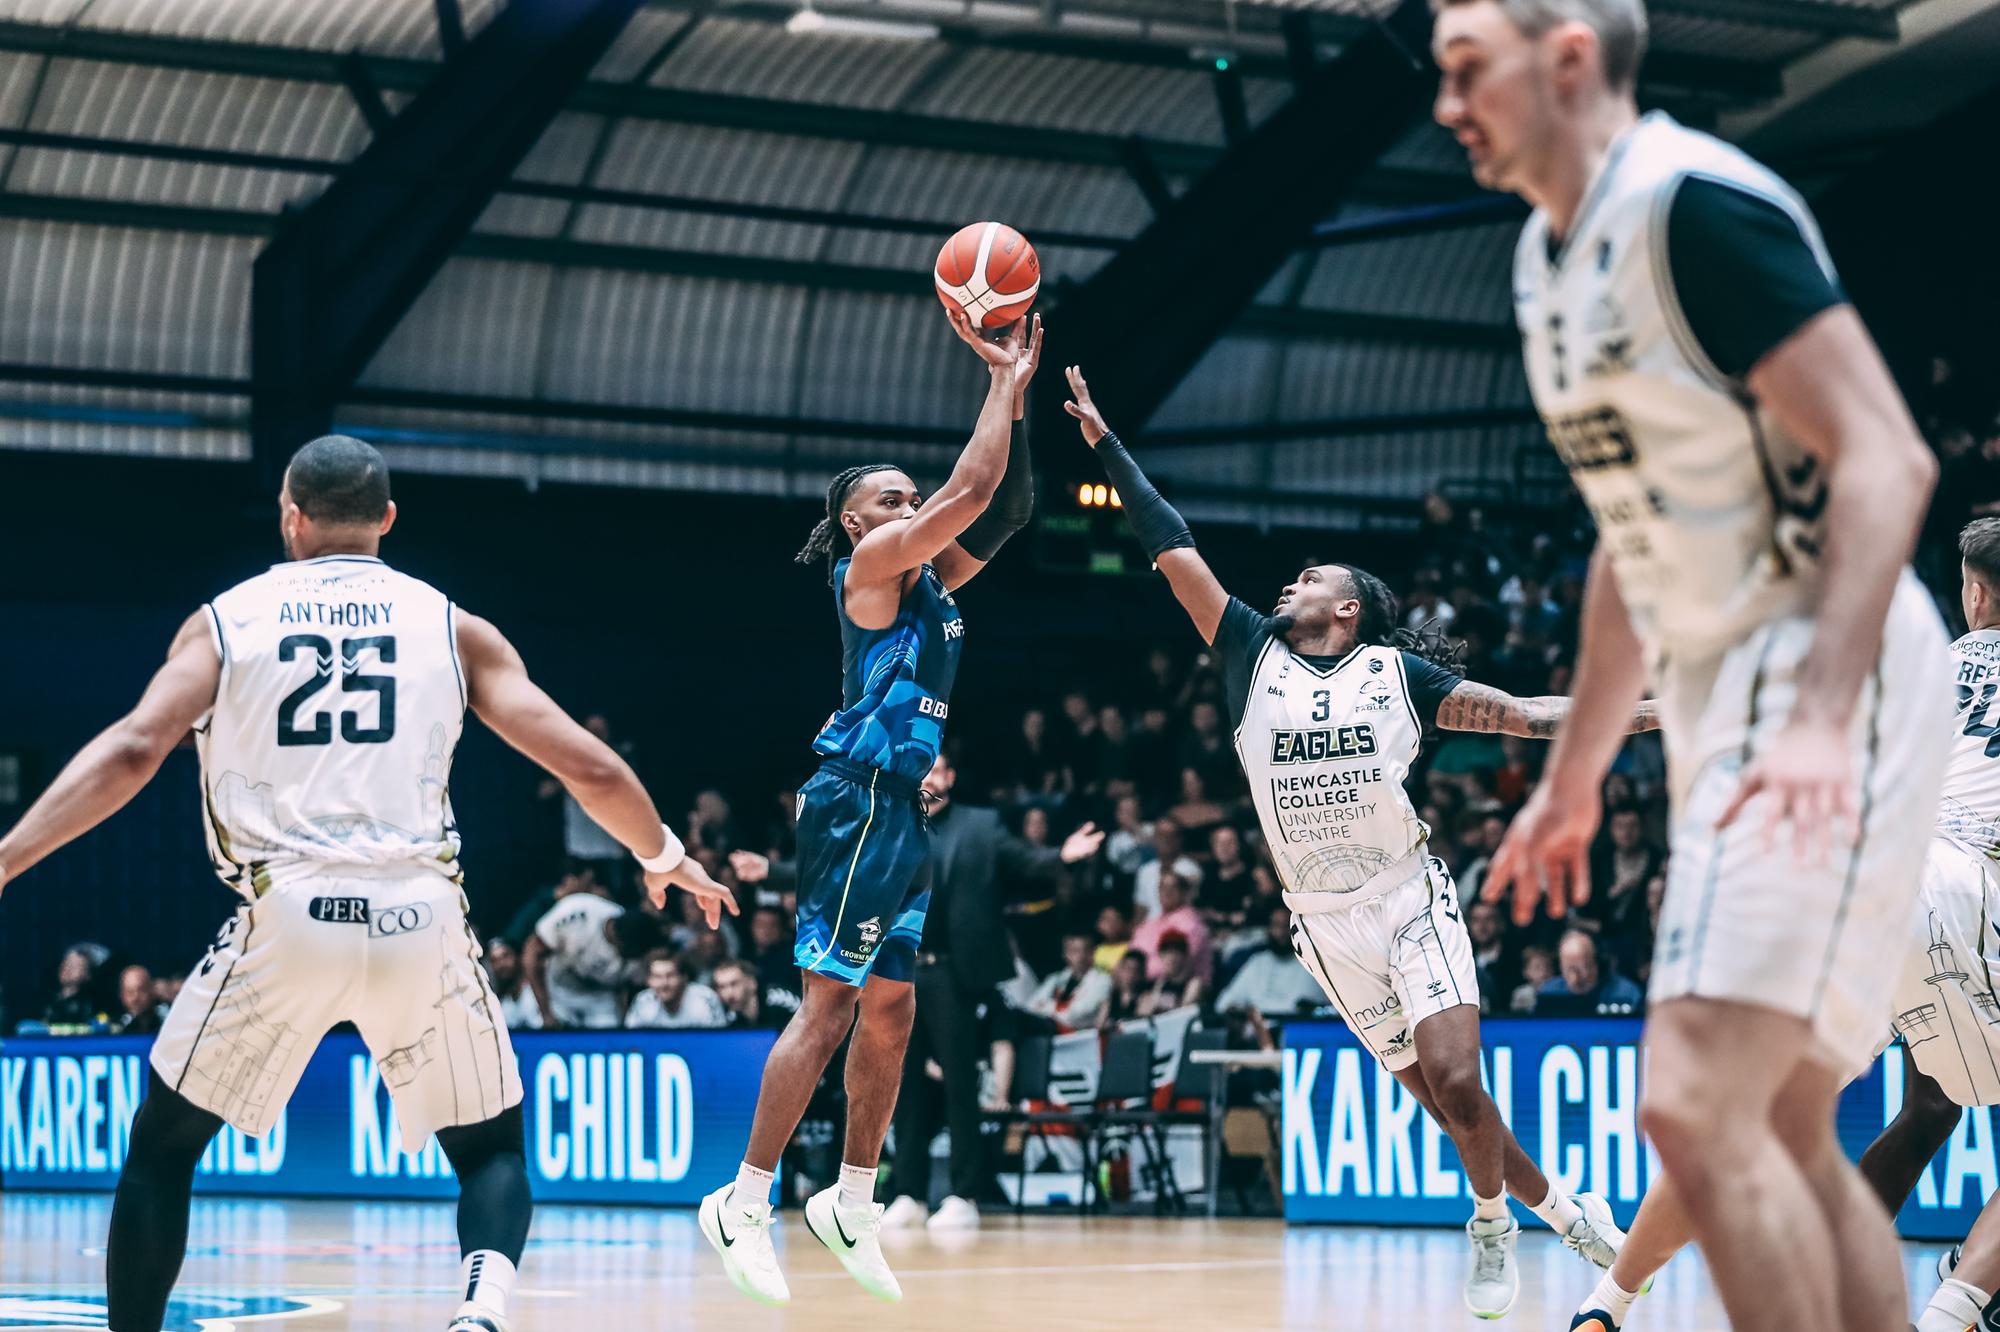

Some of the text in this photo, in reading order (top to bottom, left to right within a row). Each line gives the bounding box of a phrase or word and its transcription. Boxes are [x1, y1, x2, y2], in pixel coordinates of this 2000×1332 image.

[279, 601, 393, 627] ANTHONY
[277, 633, 396, 747] 25
[1312, 690, 1331, 722] 3
[1271, 723, 1378, 765] EAGLES
[1277, 768, 1382, 792] NEWCASTLE
[1279, 788, 1359, 810] COLLEGE
[1282, 802, 1377, 827] UNIVERSITY
[1289, 825, 1351, 843] CENTRE
[318, 900, 419, 935] PER CO
[0, 1055, 141, 1173] KAREN
[535, 1053, 694, 1182] CHILD
